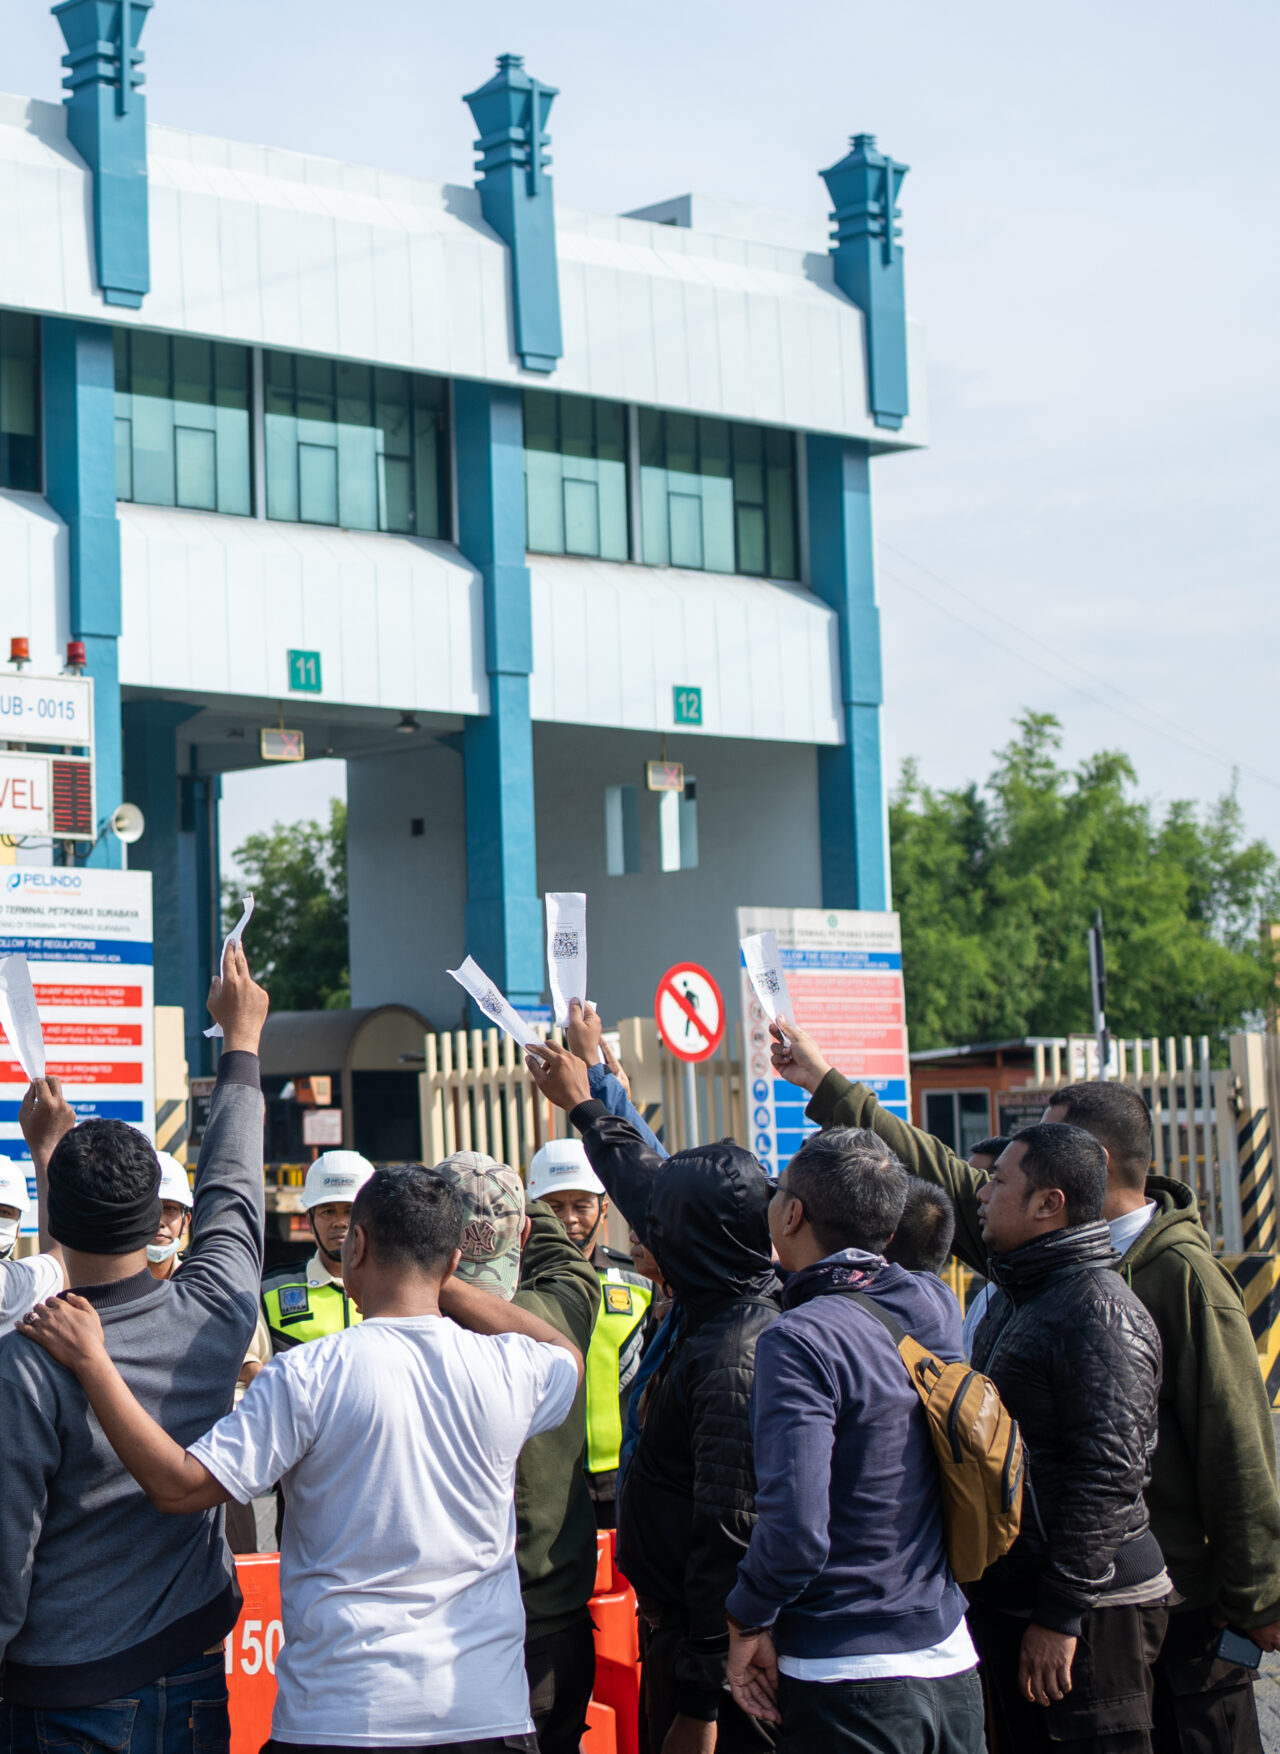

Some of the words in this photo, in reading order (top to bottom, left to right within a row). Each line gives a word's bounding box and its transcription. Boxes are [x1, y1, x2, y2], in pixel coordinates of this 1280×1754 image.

[295, 656, 317, 686] 11
[37, 698, 75, 721] 0015
[678, 692, 700, 719] 12
[23, 872, 82, 888] PELINDO
[5, 905, 45, 916] TERMINAL
[48, 906, 95, 917] PETIKEMAS
[96, 908, 140, 919] SURABAYA
[27, 938, 41, 949] THE
[43, 939, 96, 951] REGULATIONS
